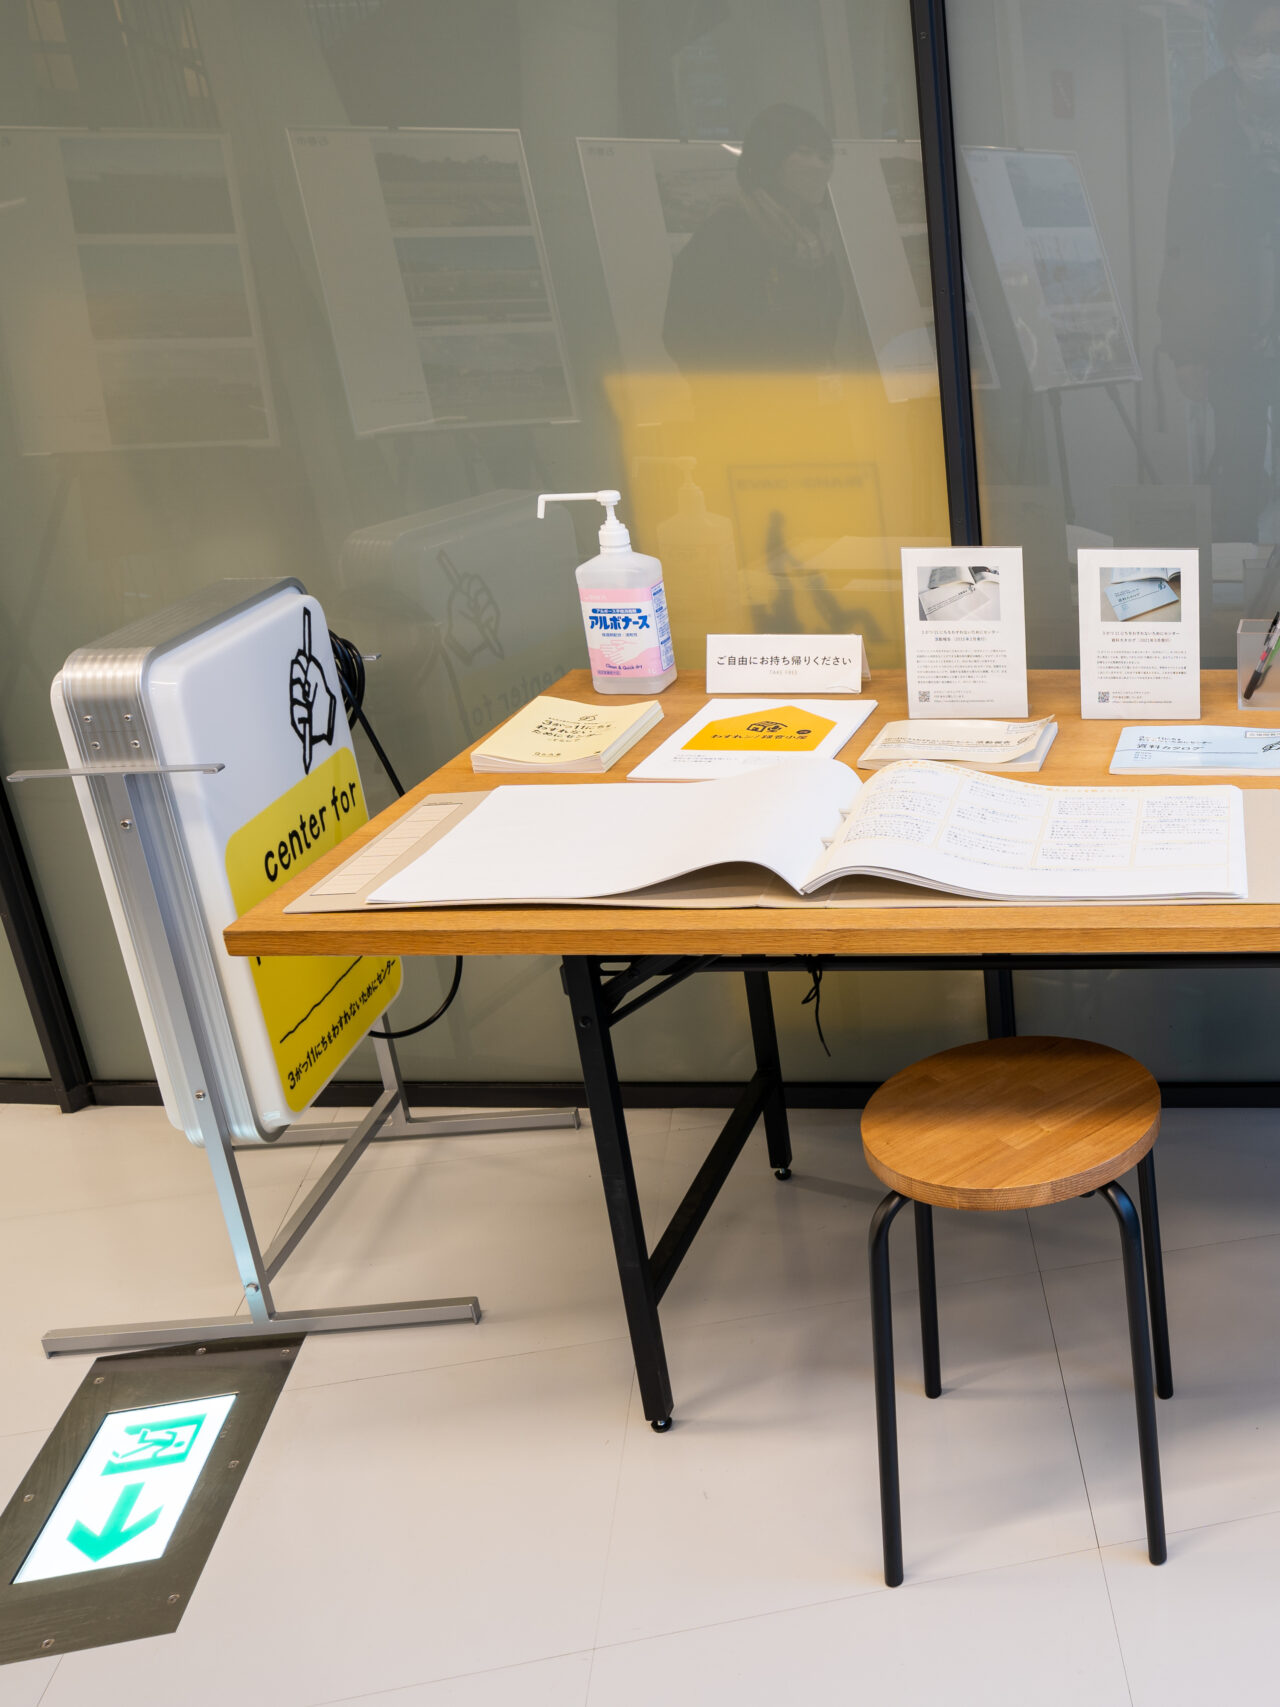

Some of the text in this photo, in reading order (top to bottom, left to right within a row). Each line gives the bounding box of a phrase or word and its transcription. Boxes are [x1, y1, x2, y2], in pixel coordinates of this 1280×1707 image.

[589, 615, 650, 630] アルボナース
[716, 655, 852, 666] ご自由にお持ち帰りください
[264, 782, 356, 882] center for
[287, 959, 396, 1090] 3がつ11にちをわすれないためにセンター
